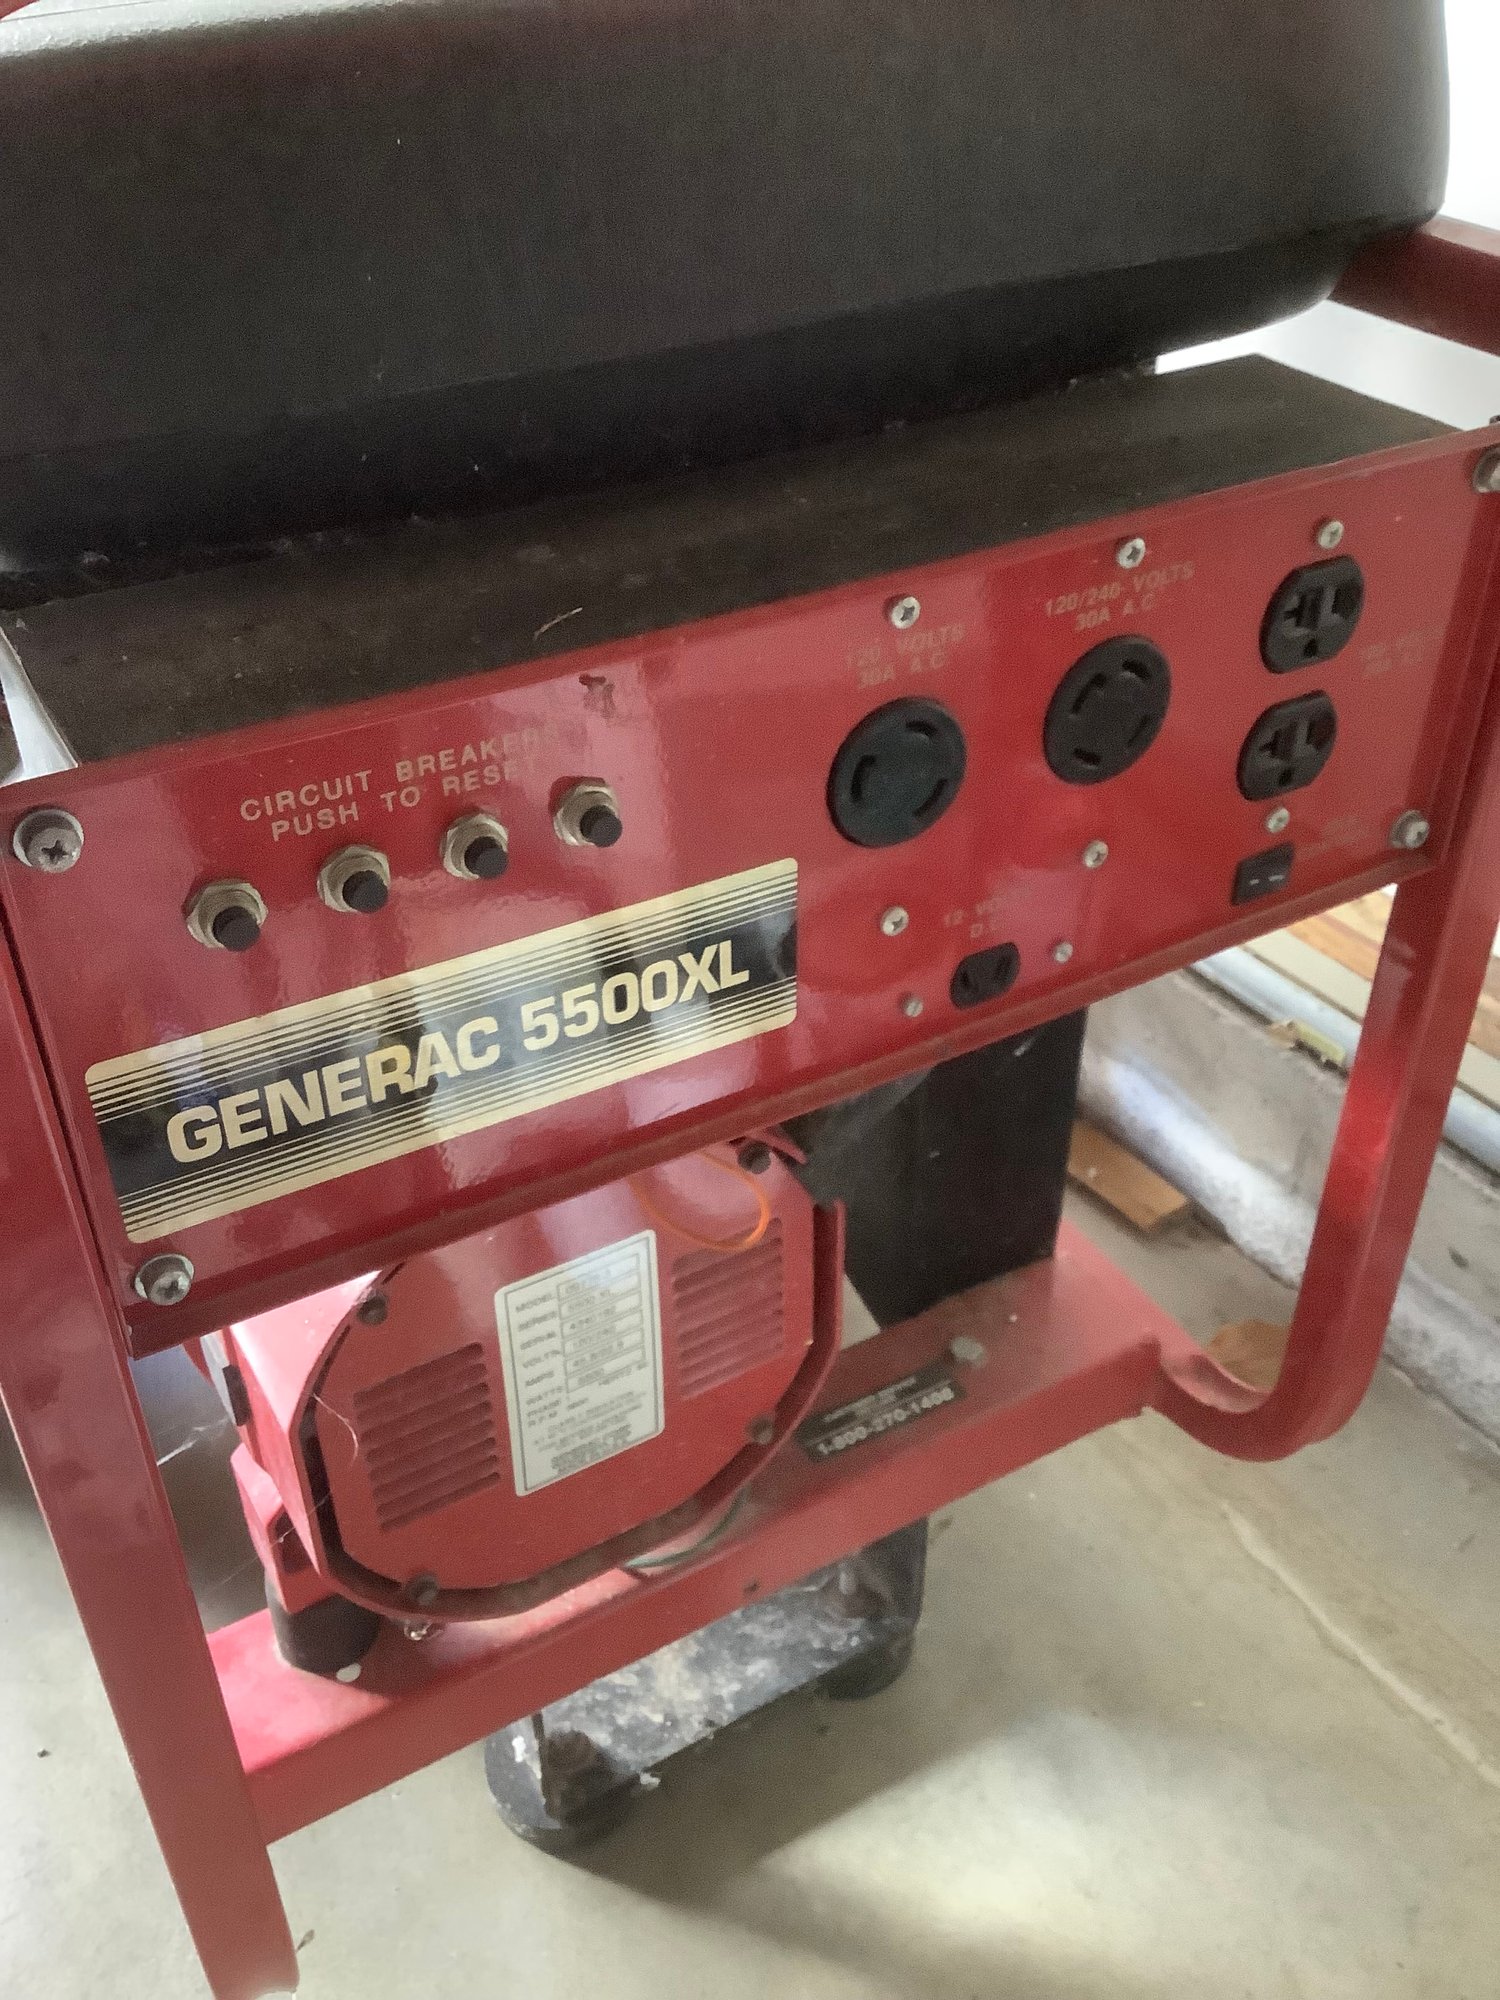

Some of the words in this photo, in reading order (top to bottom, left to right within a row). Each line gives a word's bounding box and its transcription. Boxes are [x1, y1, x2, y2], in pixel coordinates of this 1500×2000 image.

[239, 769, 373, 822] CIRCUIT
[270, 800, 360, 842] PUSH
[379, 785, 422, 813] TO
[166, 1015, 502, 1164] GENERAC
[519, 939, 751, 1053] 5500XL
